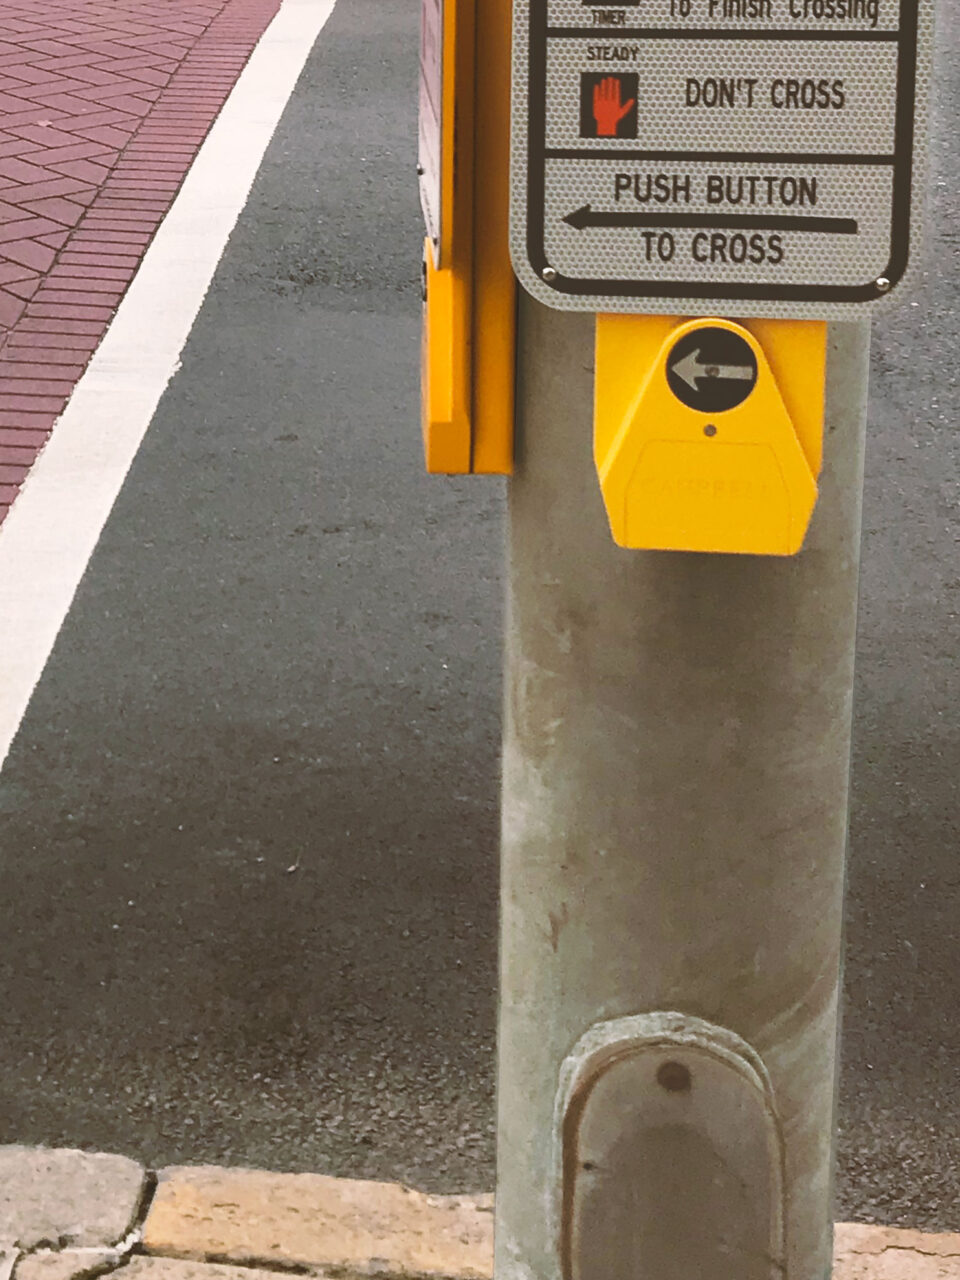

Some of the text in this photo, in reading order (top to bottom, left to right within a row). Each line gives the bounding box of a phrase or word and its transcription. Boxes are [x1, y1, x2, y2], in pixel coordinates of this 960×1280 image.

[591, 9, 626, 25] TIMER
[587, 46, 639, 61] STEADY
[686, 77, 846, 109] DON'T CROSS
[614, 173, 818, 206] PUSH BUTTON
[641, 231, 784, 264] TO CROSS
